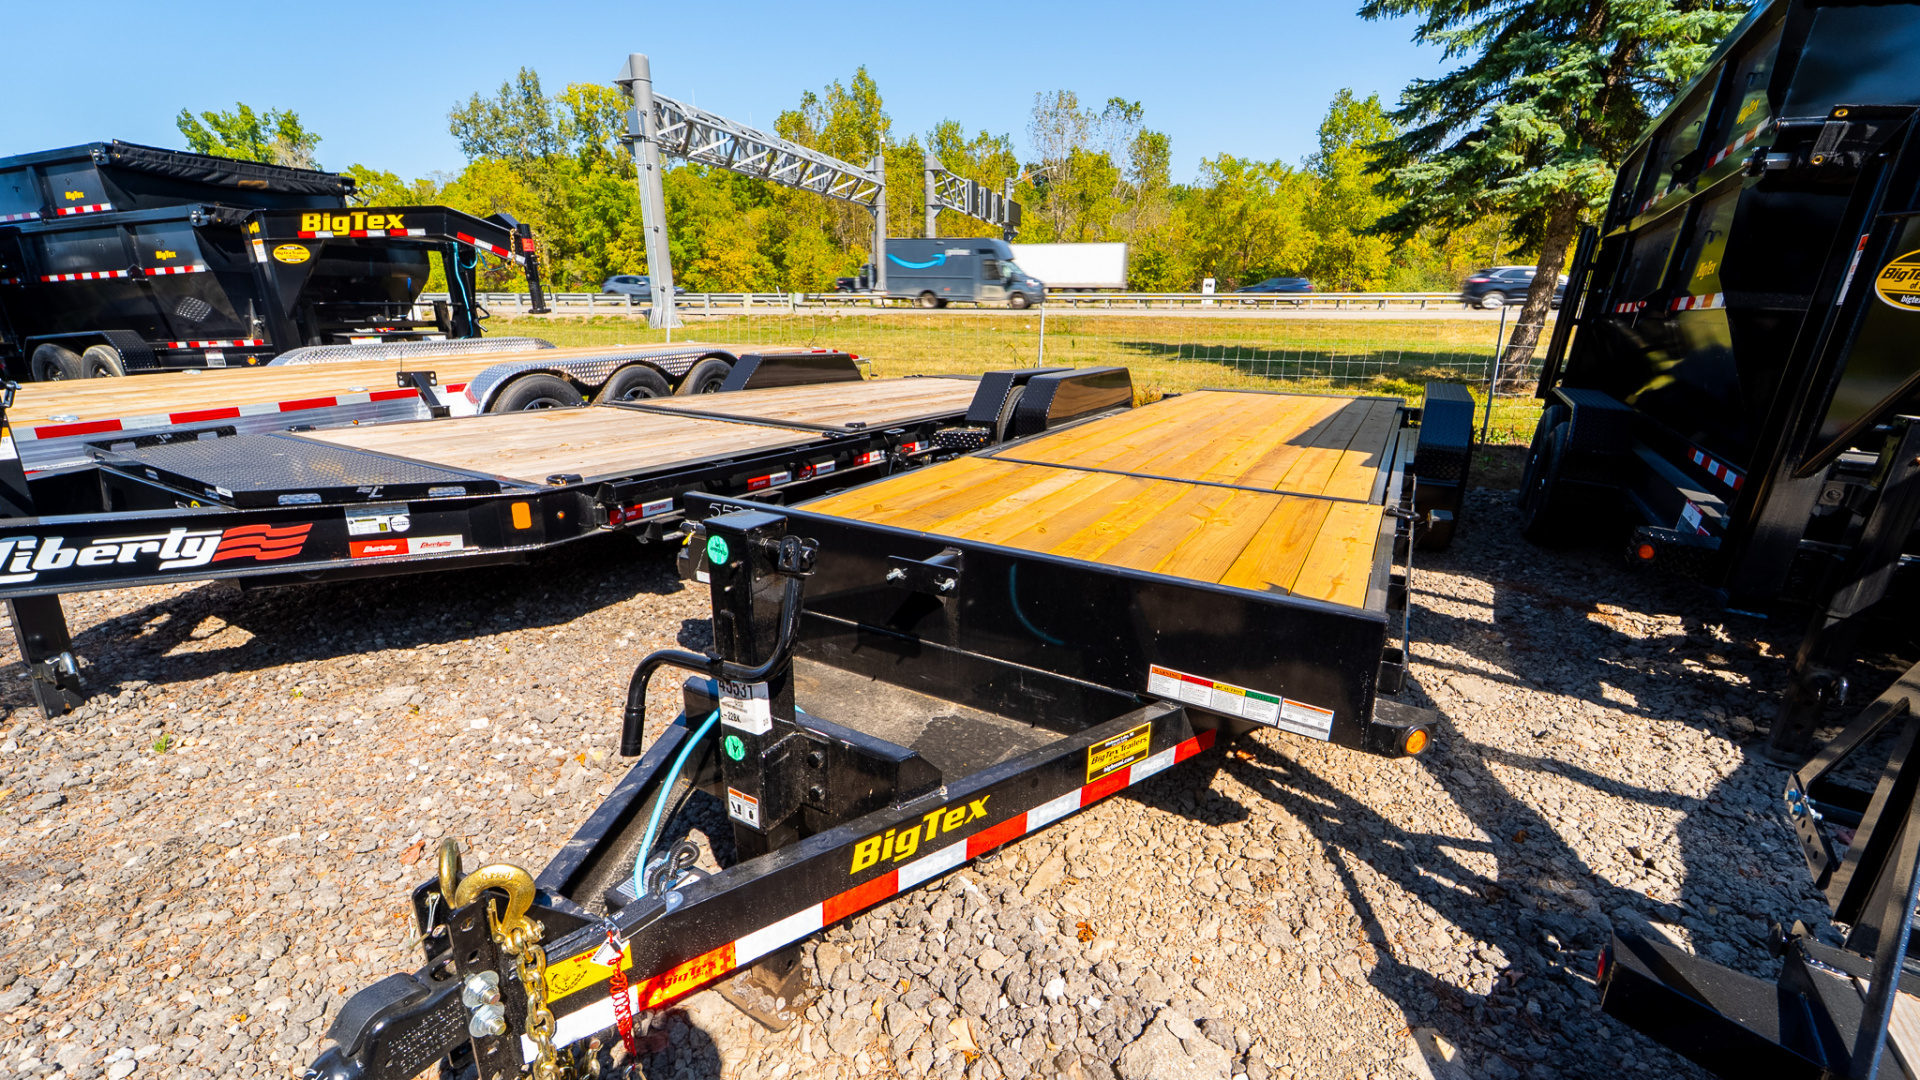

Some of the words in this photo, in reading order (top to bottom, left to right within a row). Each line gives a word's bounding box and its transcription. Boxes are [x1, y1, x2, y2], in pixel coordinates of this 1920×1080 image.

[302, 211, 405, 236] BigTex
[1881, 267, 1920, 282] BigTe
[1091, 748, 1119, 765] BigTex
[1120, 736, 1148, 752] Trailers
[849, 794, 991, 875] BigTex
